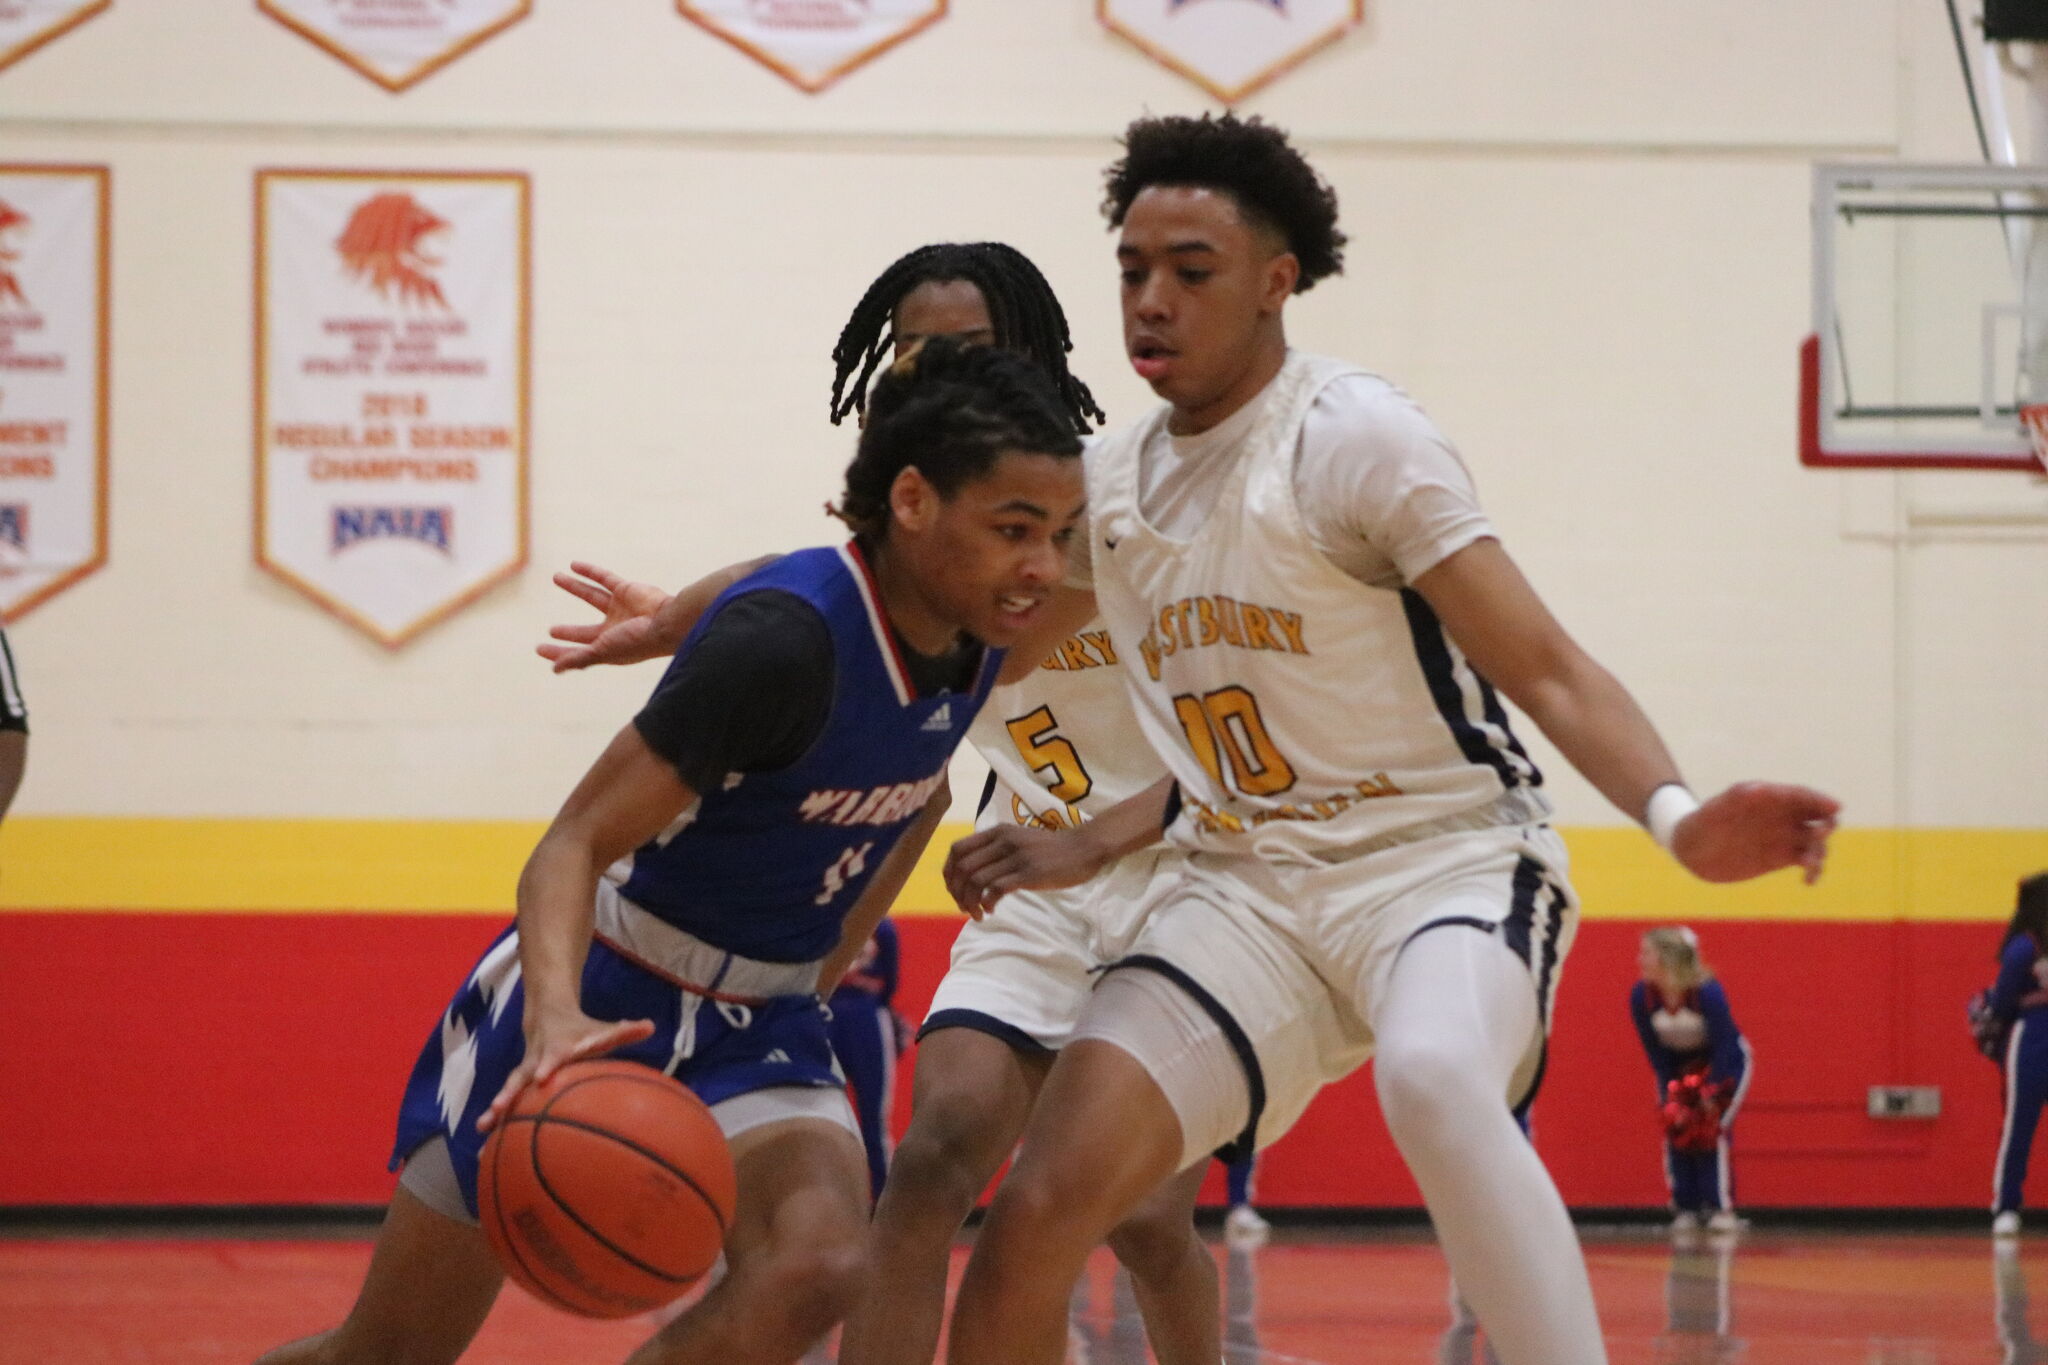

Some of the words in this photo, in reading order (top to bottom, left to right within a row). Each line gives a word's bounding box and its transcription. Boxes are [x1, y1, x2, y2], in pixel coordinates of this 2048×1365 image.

[276, 425, 396, 448] REGULAR
[410, 426, 511, 449] SEASON
[308, 456, 478, 481] CHAMPIONS
[333, 505, 451, 552] NAIA
[1138, 594, 1311, 682] WSTBURY
[1005, 704, 1093, 804] 5
[1172, 684, 1298, 801] 10
